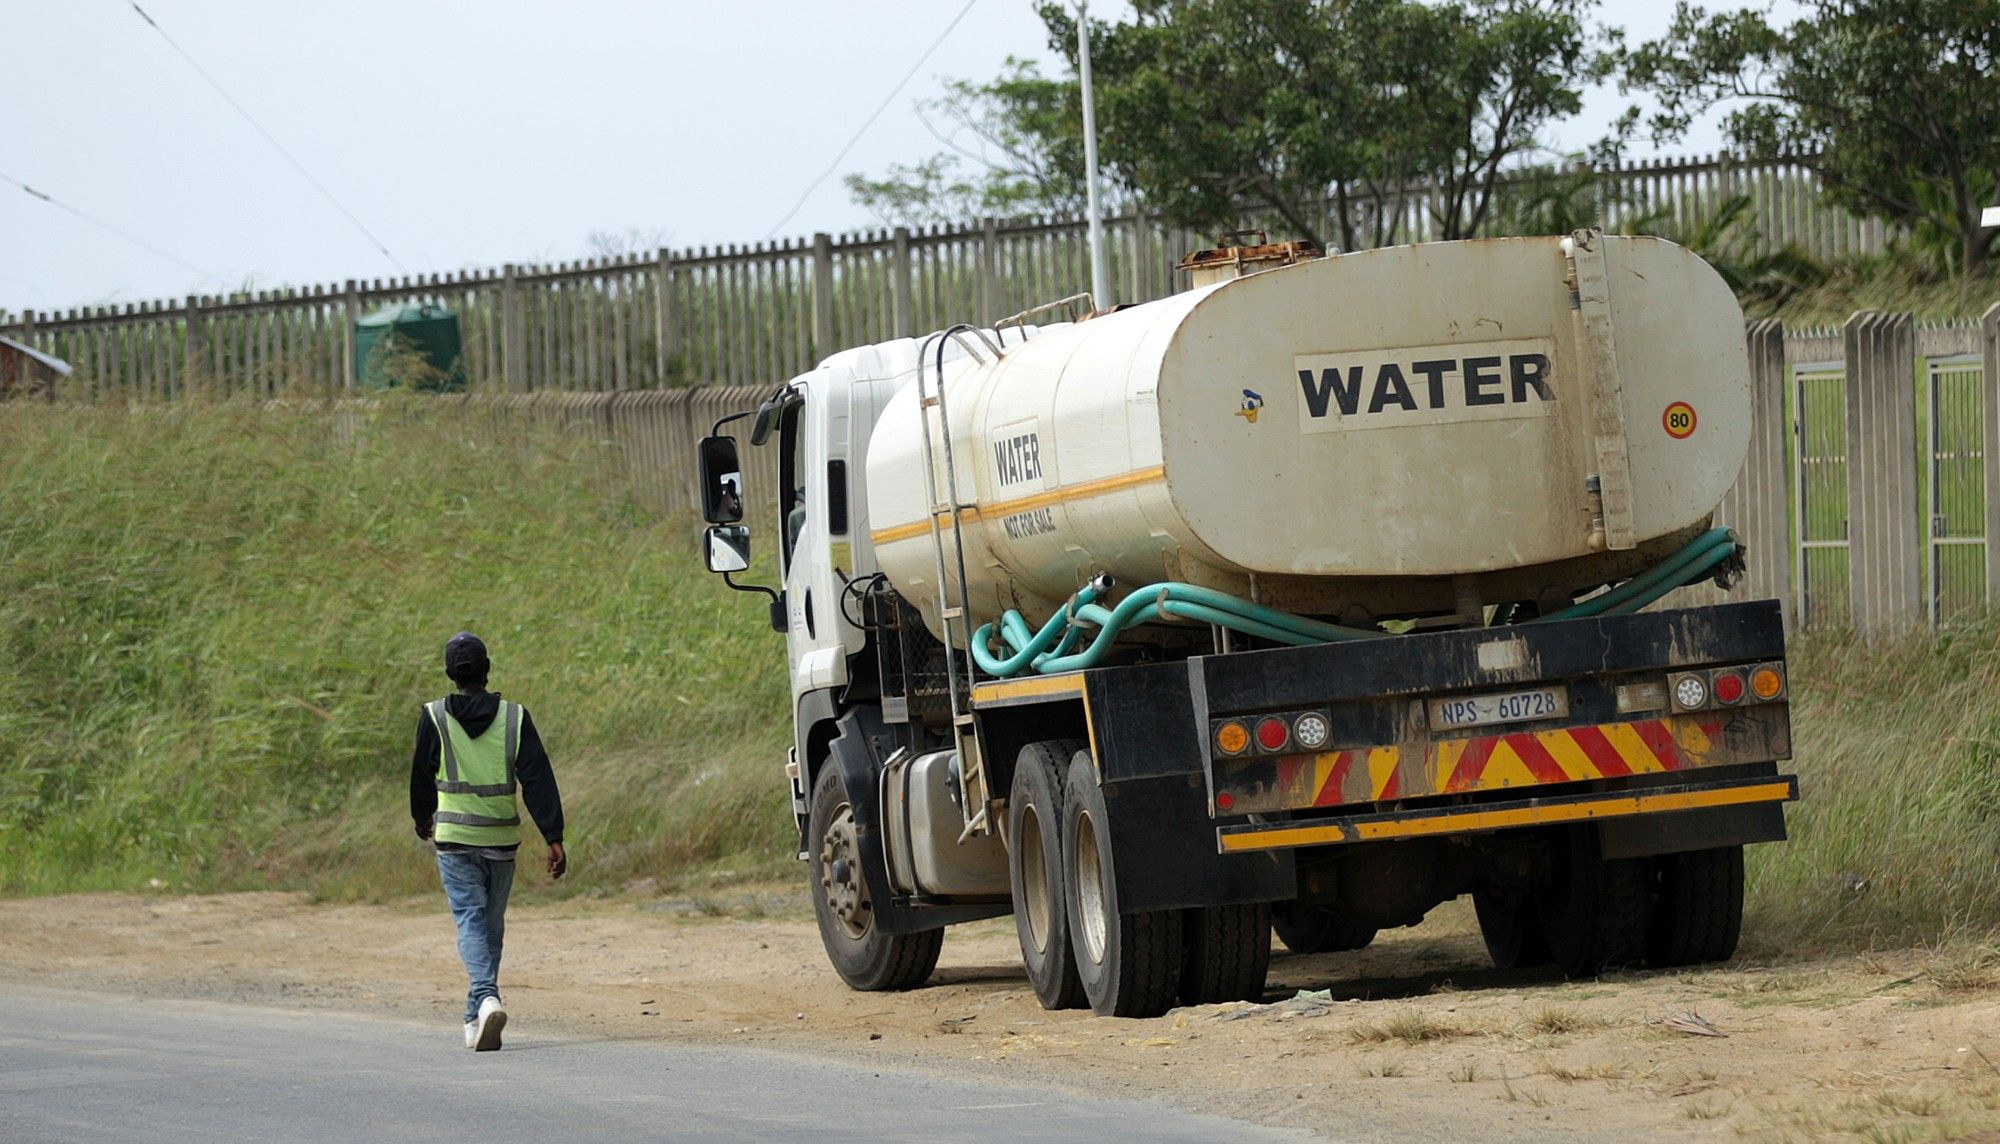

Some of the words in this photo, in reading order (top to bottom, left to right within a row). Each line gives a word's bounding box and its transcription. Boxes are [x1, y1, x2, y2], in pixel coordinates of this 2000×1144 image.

[1298, 353, 1557, 417] WATER
[1670, 413, 1689, 428] 80
[994, 433, 1042, 487] WATER
[1003, 515, 1023, 540] NOT
[1019, 512, 1040, 537] FOR
[1034, 508, 1056, 534] SALE
[1441, 700, 1478, 723] NPS
[1499, 693, 1556, 719] 60728
